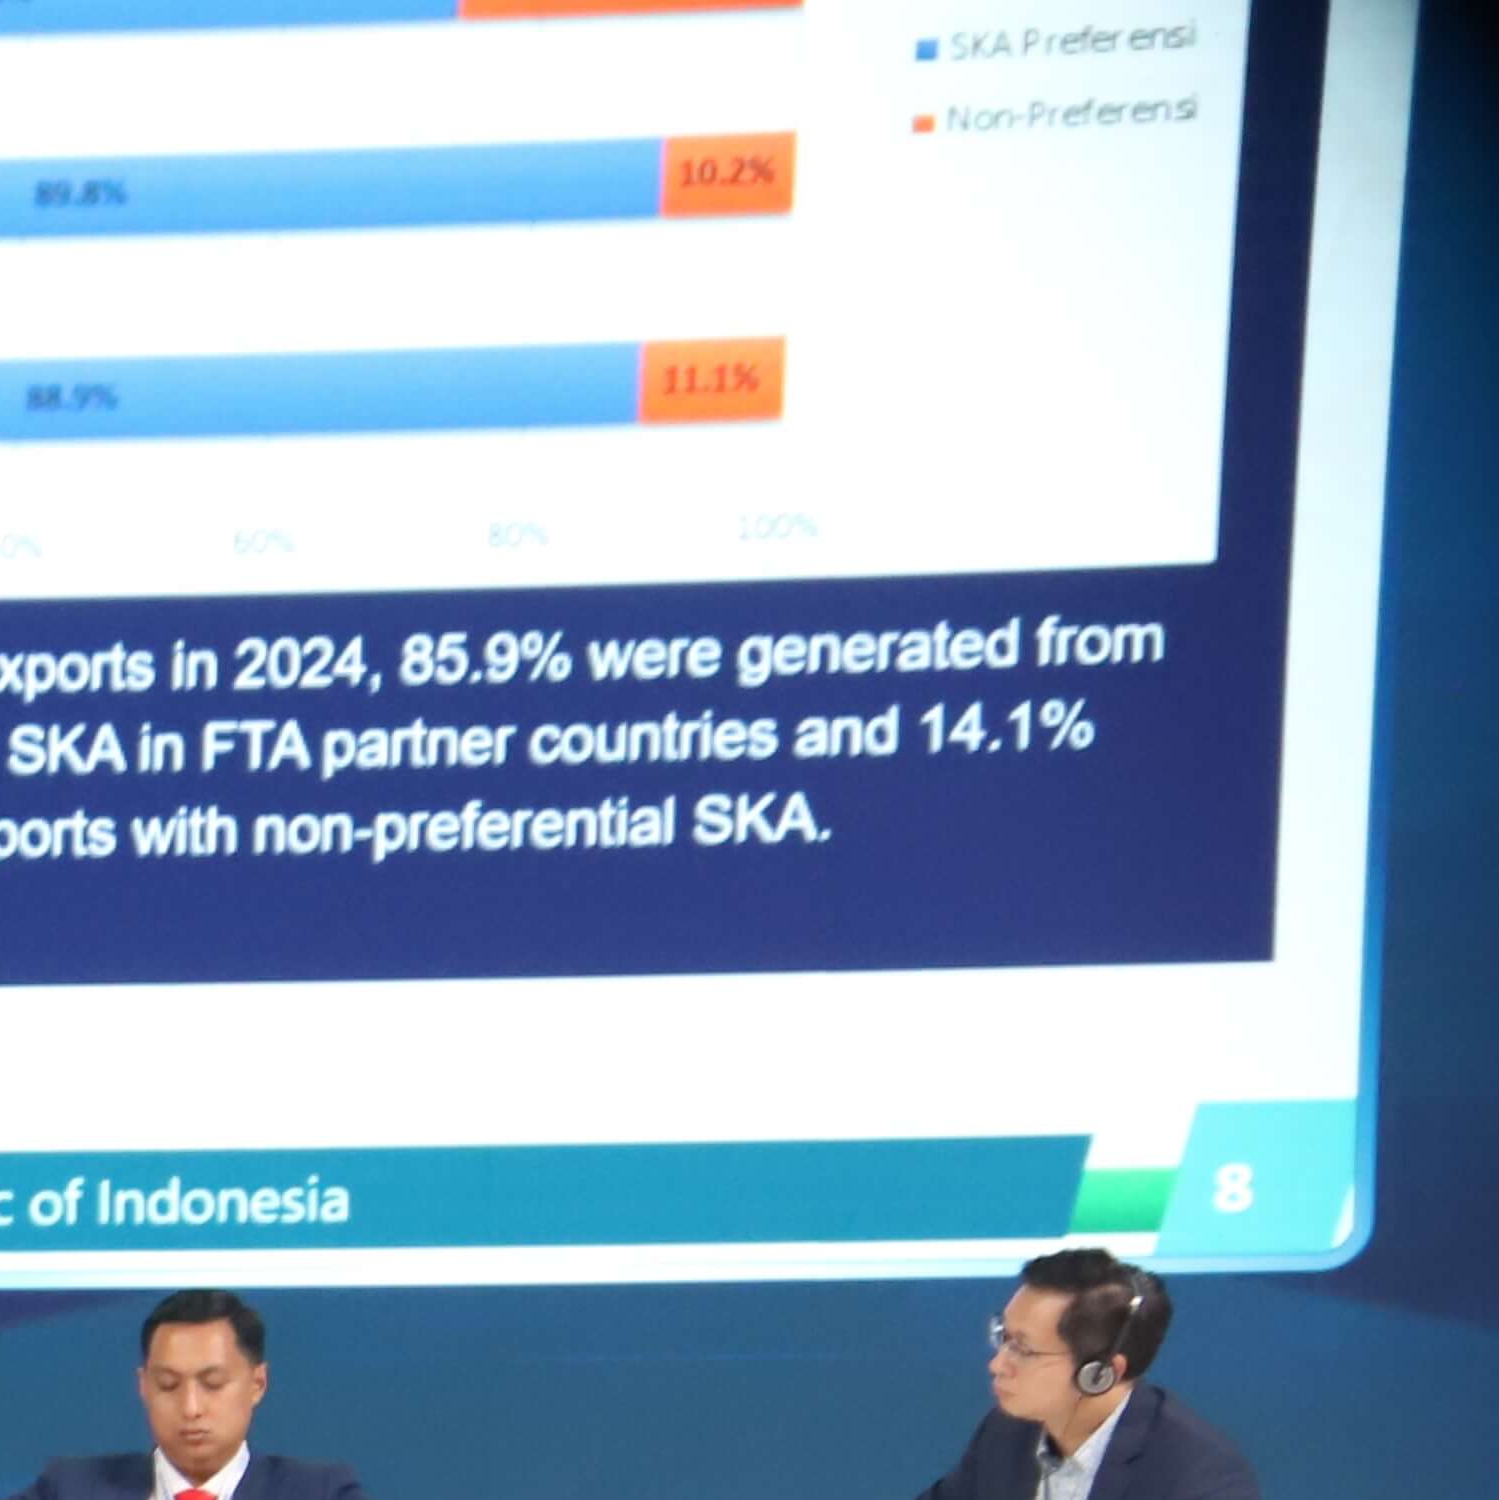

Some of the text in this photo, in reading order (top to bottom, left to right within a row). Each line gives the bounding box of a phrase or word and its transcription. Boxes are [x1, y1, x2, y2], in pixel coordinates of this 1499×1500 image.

[952, 18, 1198, 60] SKA Preferensi
[948, 92, 1199, 130] Non-Preferensi
[680, 157, 775, 189] 10.2%
[662, 364, 760, 400] 11.1%
[172, 639, 218, 690] in
[233, 635, 381, 693] 2024,
[400, 630, 572, 686] 85.9%
[588, 637, 722, 680] were
[737, 617, 1020, 688] generated
[1036, 615, 1164, 666] from
[8, 723, 127, 775] SKA
[138, 722, 184, 772] in
[202, 719, 311, 772] FTA
[322, 718, 517, 780] partner
[528, 710, 779, 765] countries
[794, 704, 899, 758] and
[921, 699, 1094, 753] 14.1%
[130, 805, 237, 856] with
[254, 795, 676, 863] non-preferential
[693, 792, 831, 845] SKA.
[28, 1176, 85, 1226] of
[98, 1174, 349, 1225] Indonesia
[1212, 1162, 1254, 1213] 8
